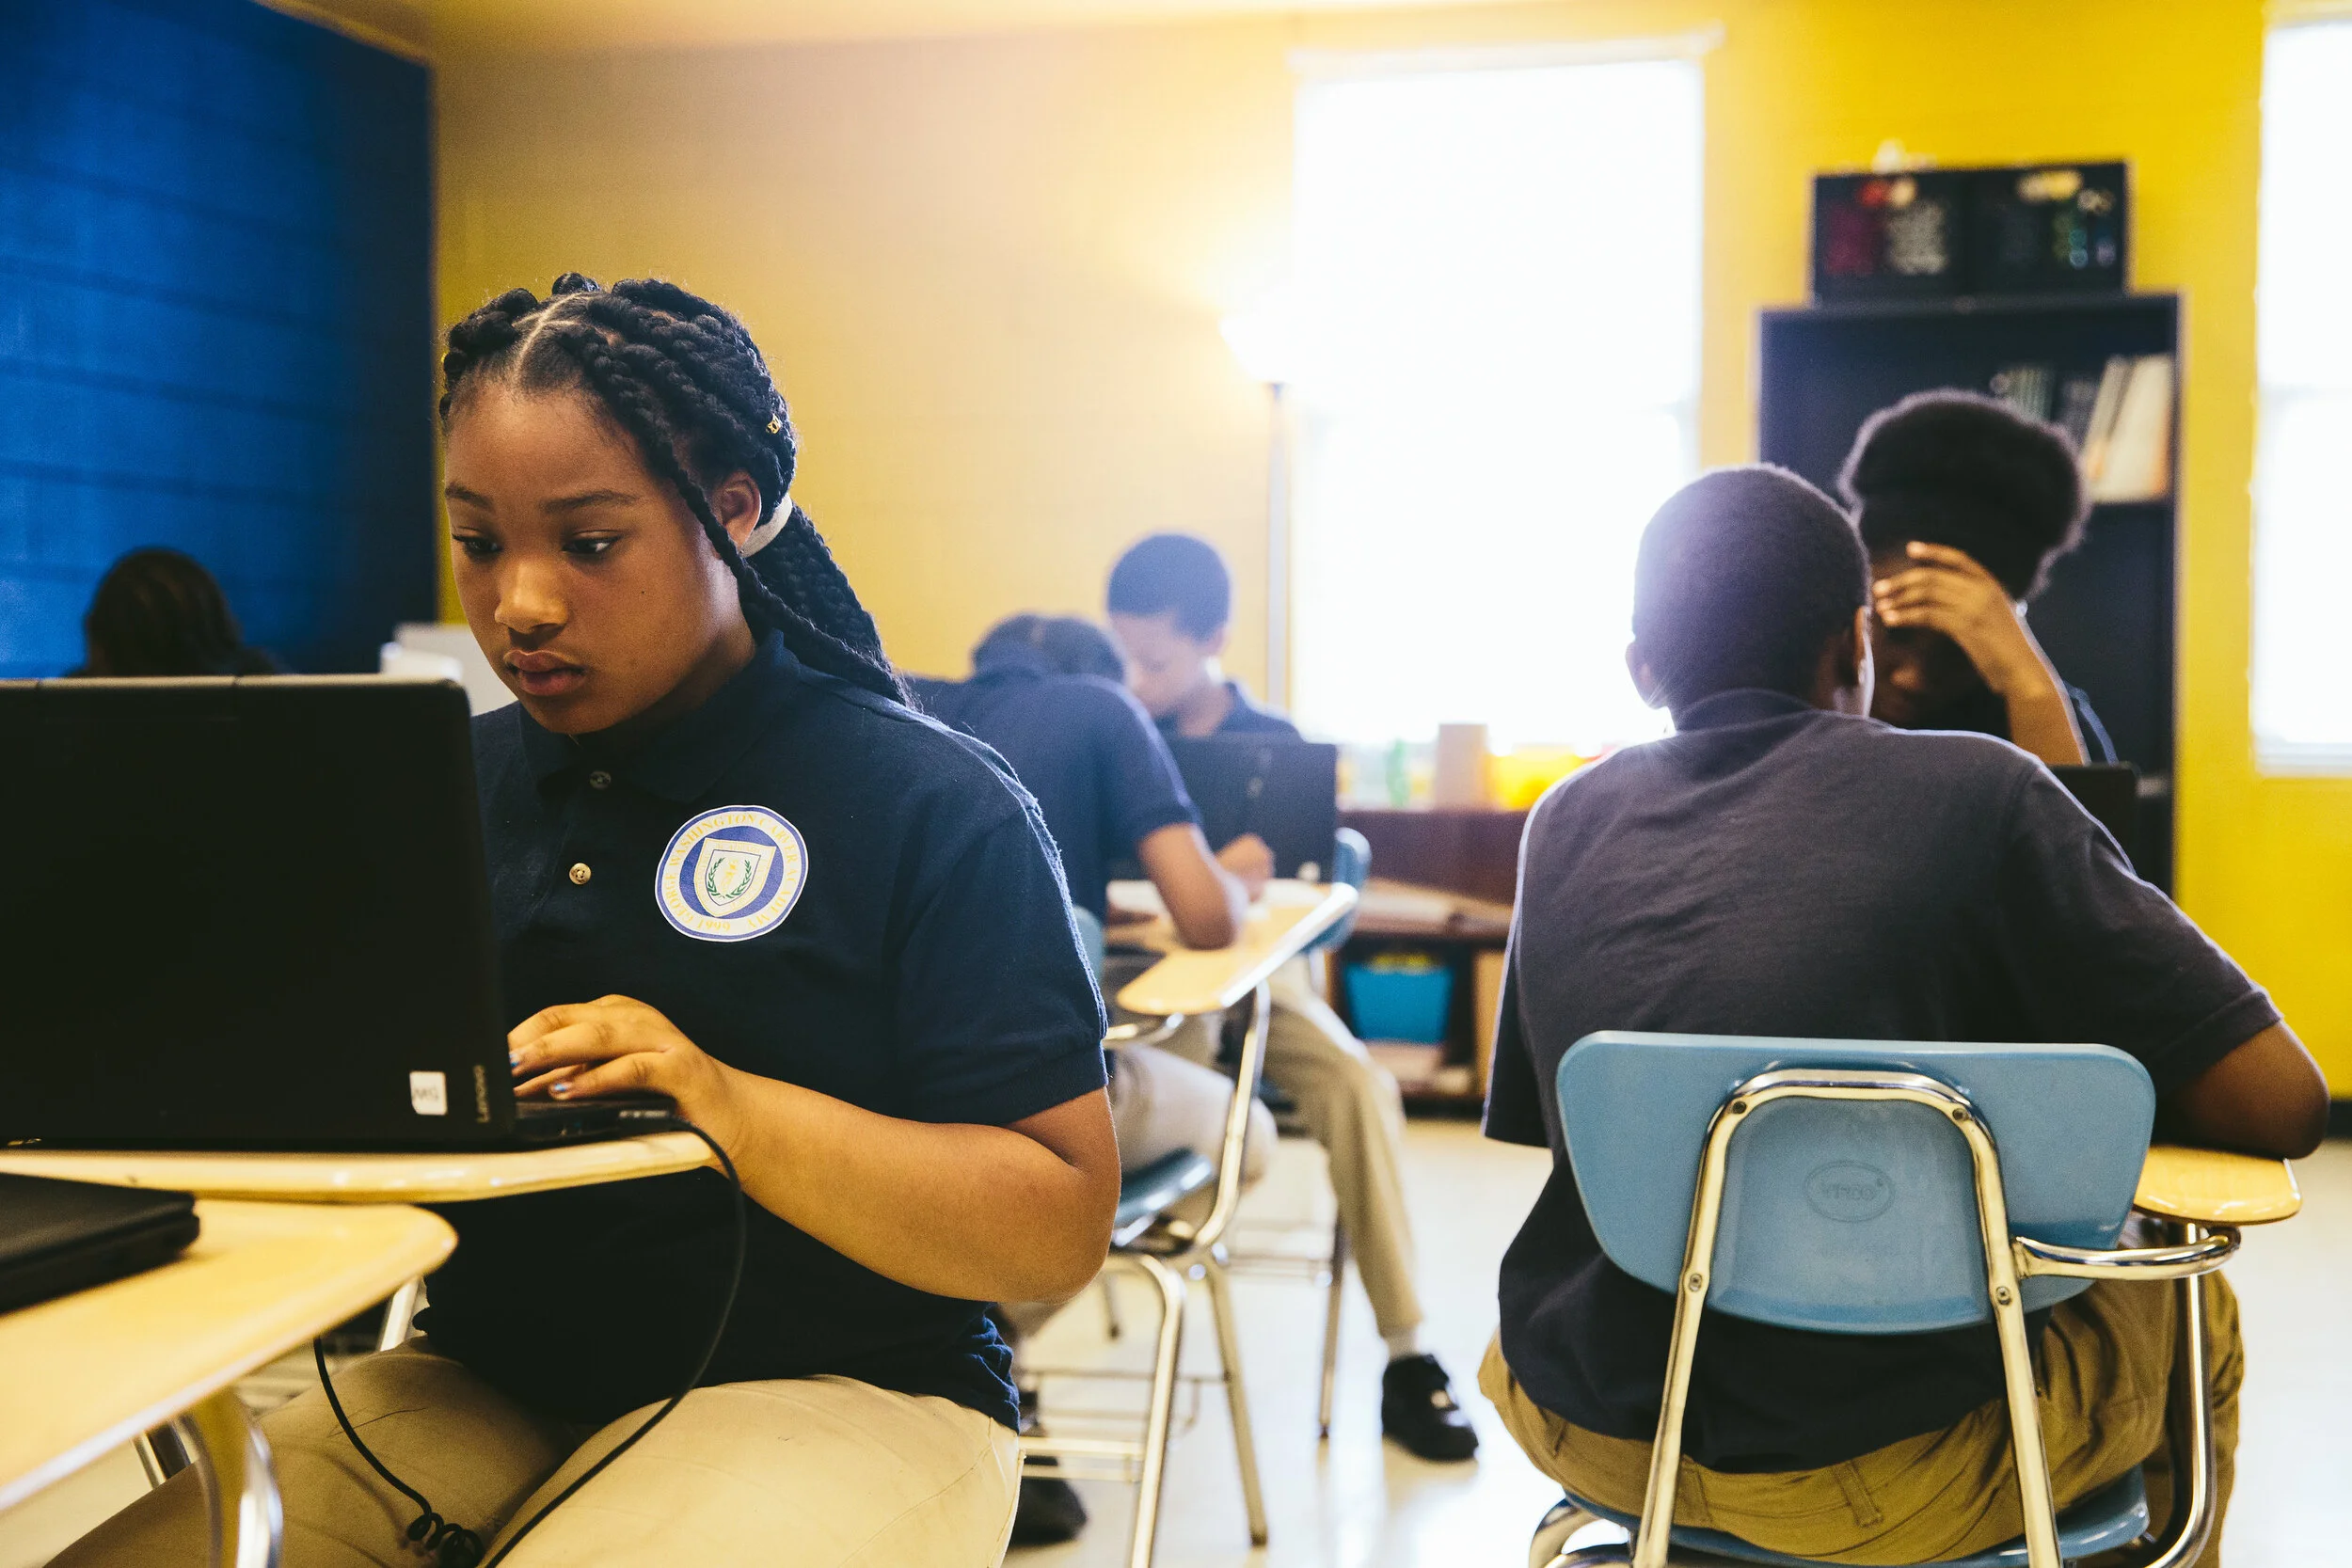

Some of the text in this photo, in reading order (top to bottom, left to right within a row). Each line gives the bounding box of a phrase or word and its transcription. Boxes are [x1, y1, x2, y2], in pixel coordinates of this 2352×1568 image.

[670, 814, 757, 866] WASHINGTON
[759, 817, 798, 863] CARVER
[665, 873, 693, 925] GEORGE
[747, 869, 799, 928] ACADEMY
